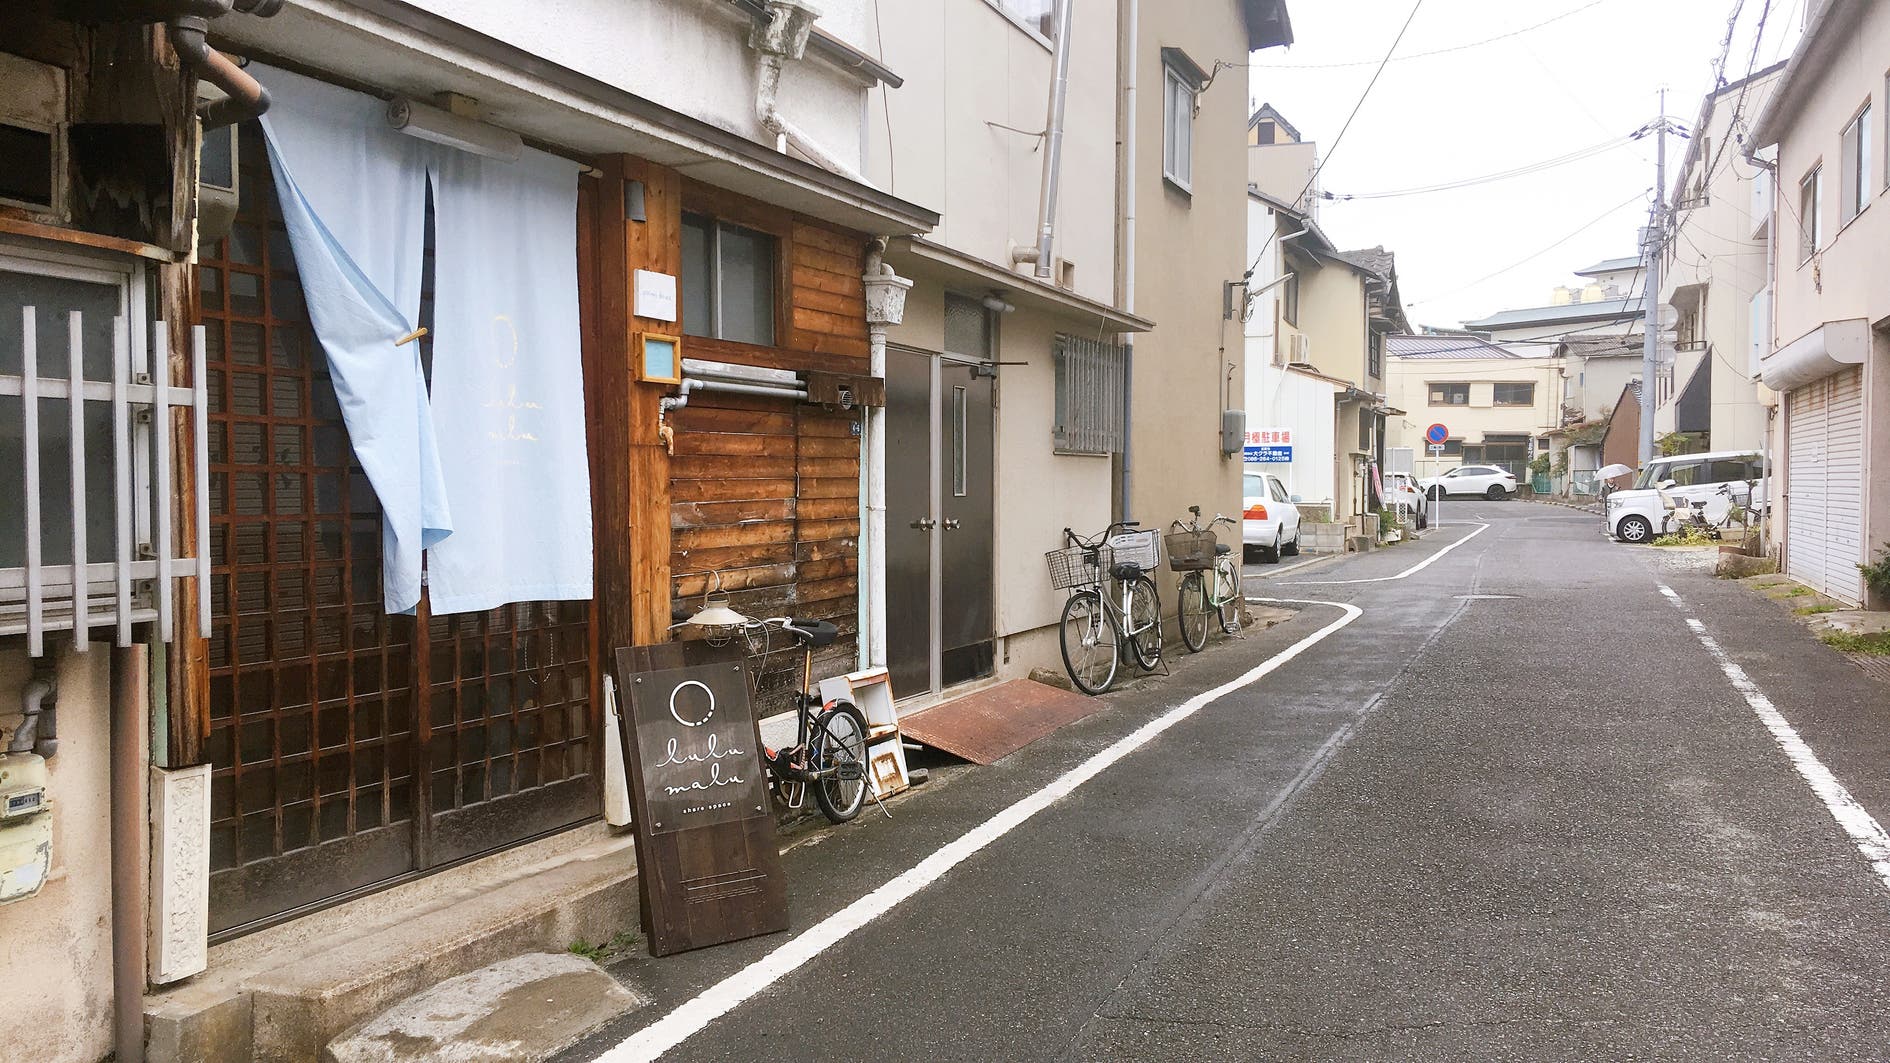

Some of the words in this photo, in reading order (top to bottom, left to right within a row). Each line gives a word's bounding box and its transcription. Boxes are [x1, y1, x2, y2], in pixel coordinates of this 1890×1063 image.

[1244, 431, 1290, 443] 月極駐車場
[655, 733, 745, 768] lulu
[664, 762, 745, 796] malu
[683, 806, 705, 814] share
[708, 802, 731, 810] space
